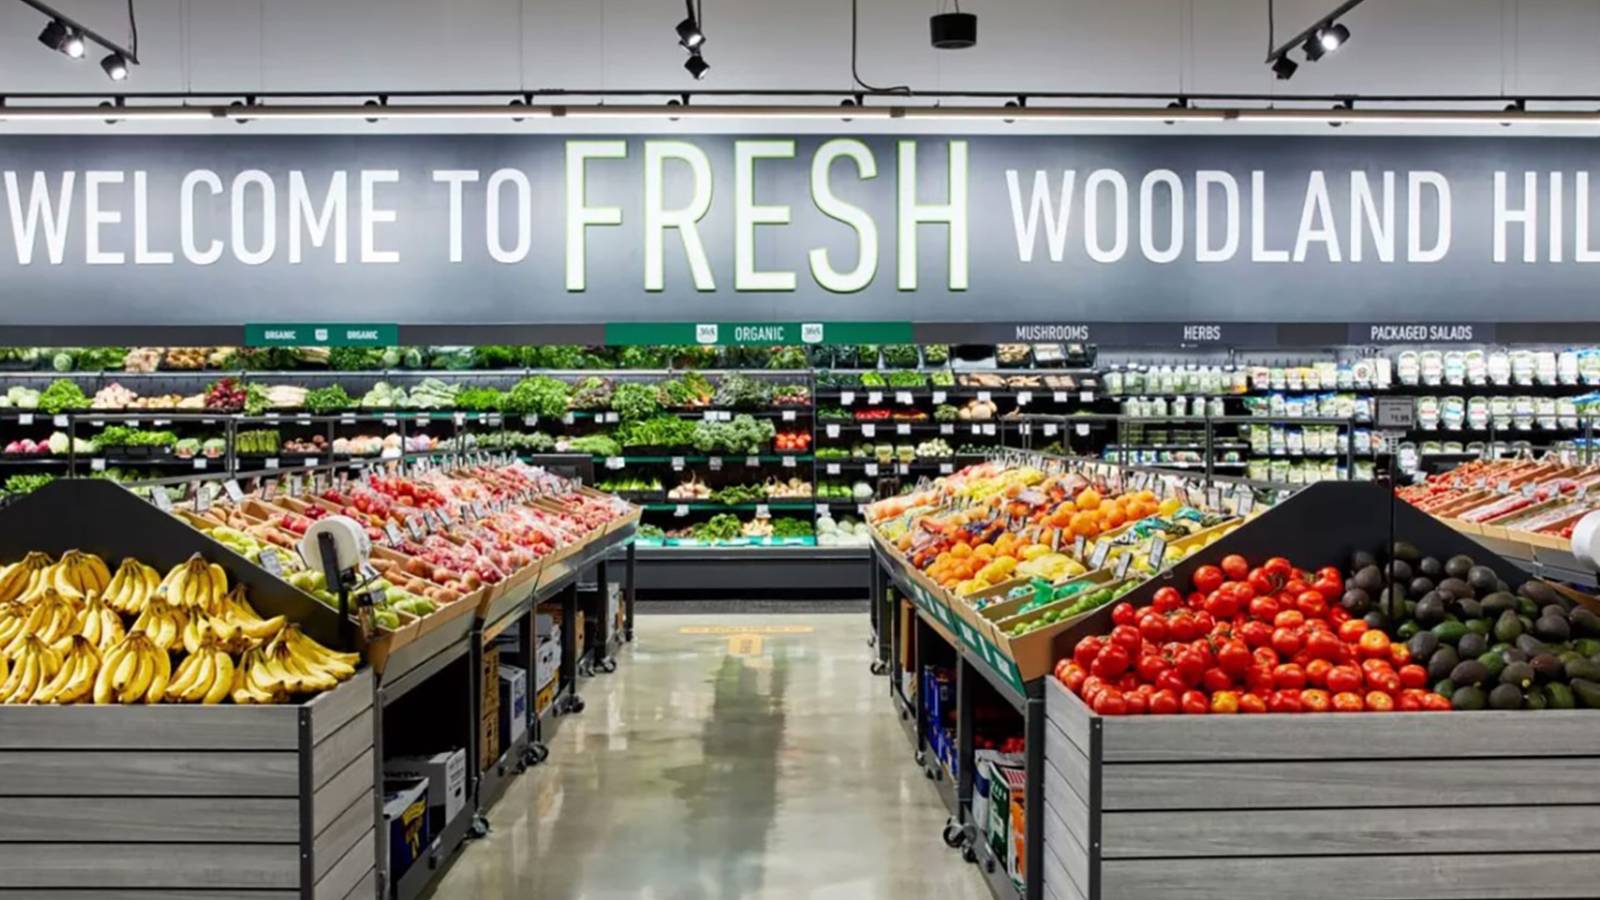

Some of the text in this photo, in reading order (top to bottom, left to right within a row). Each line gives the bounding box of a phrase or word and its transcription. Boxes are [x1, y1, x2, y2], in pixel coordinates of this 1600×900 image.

[4, 170, 400, 265] WELCOME
[433, 169, 531, 264] TO
[565, 138, 969, 294] FRESH
[1006, 169, 1452, 264] WOODLAND
[734, 326, 784, 341] ORGANIC
[1015, 325, 1089, 341] MUSHROOMS
[1183, 325, 1221, 341] HERBS
[1370, 325, 1473, 341] PACKAGED SALADS
